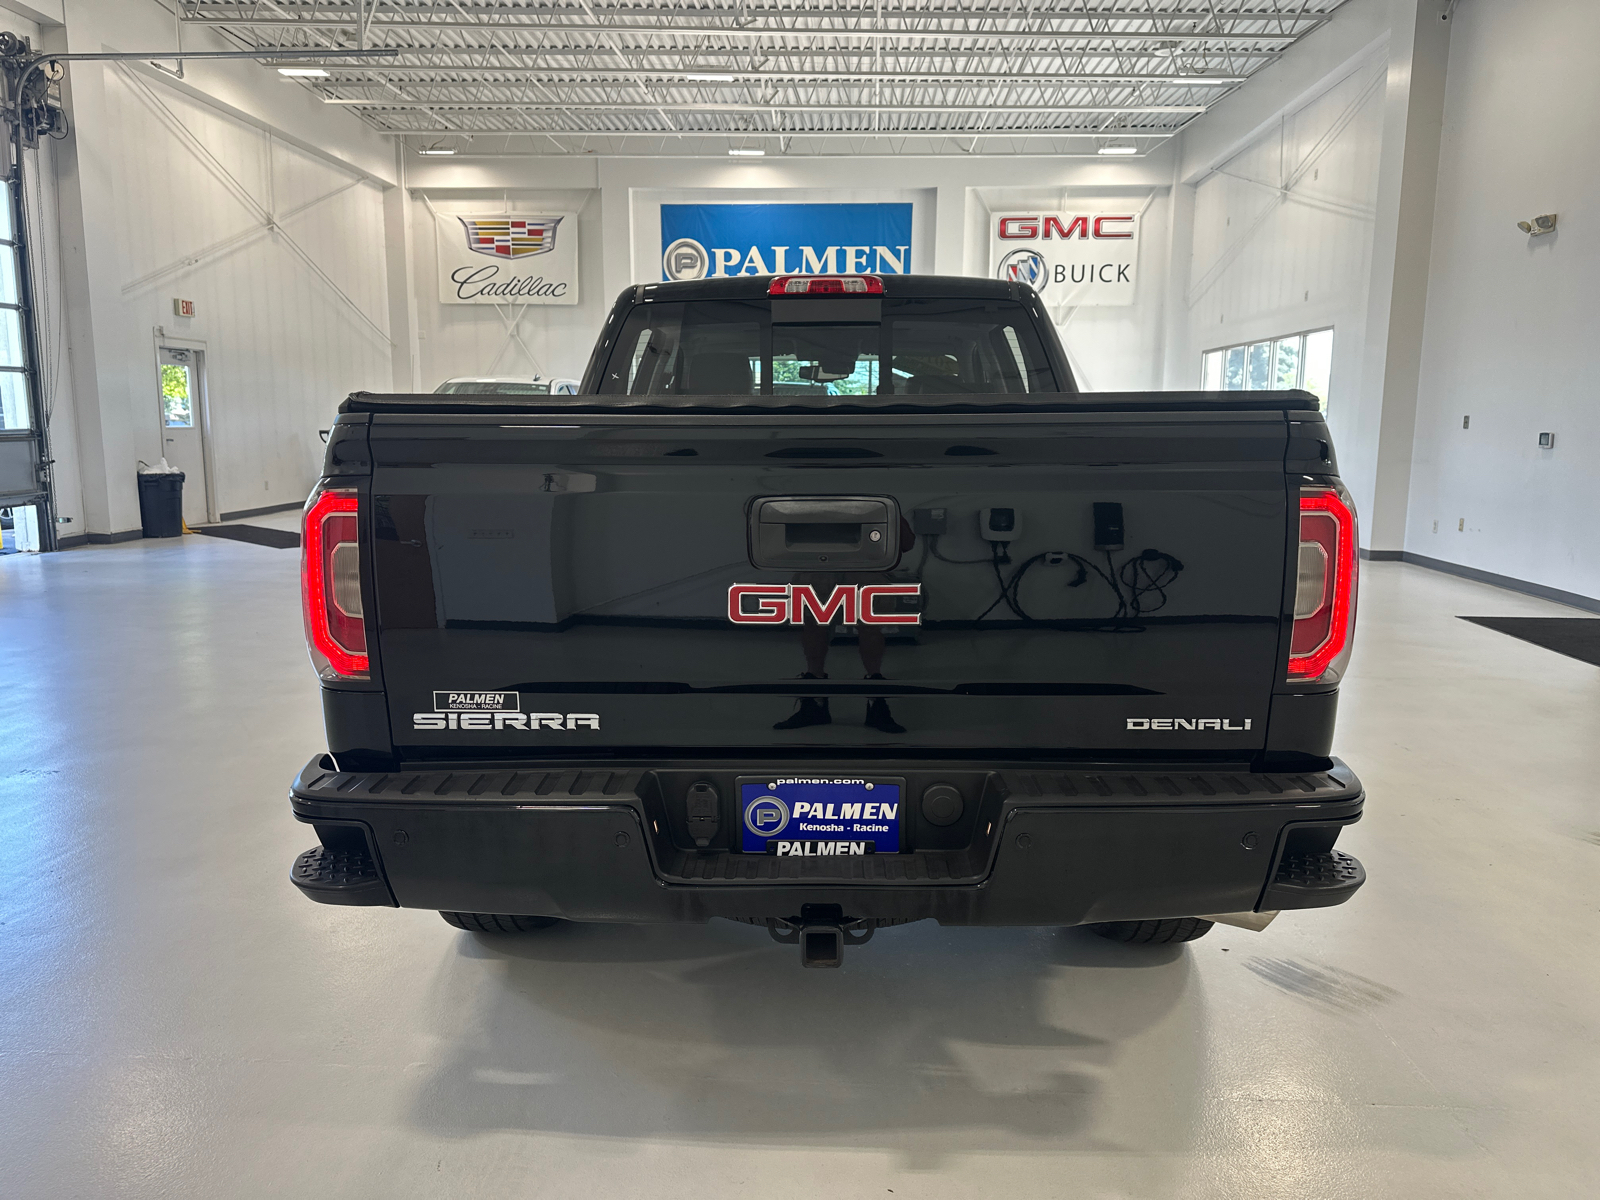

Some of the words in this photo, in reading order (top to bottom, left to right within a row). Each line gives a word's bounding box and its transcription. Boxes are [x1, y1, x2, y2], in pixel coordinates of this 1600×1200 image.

[998, 215, 1135, 240] GMC
[711, 245, 909, 277] PALMEN
[451, 265, 567, 299] Cadillac
[1054, 264, 1130, 283] BUICK
[182, 300, 193, 315] EXIT
[728, 583, 921, 625] GMC
[448, 694, 505, 704] PALMEN
[413, 712, 600, 730] SIERRA
[1126, 718, 1252, 730] DENALI
[776, 778, 865, 786] palmen.com
[792, 802, 898, 820] PALMEN
[799, 823, 844, 832] Kenosha
[853, 824, 889, 832] Racine
[776, 841, 866, 856] PALMEN
